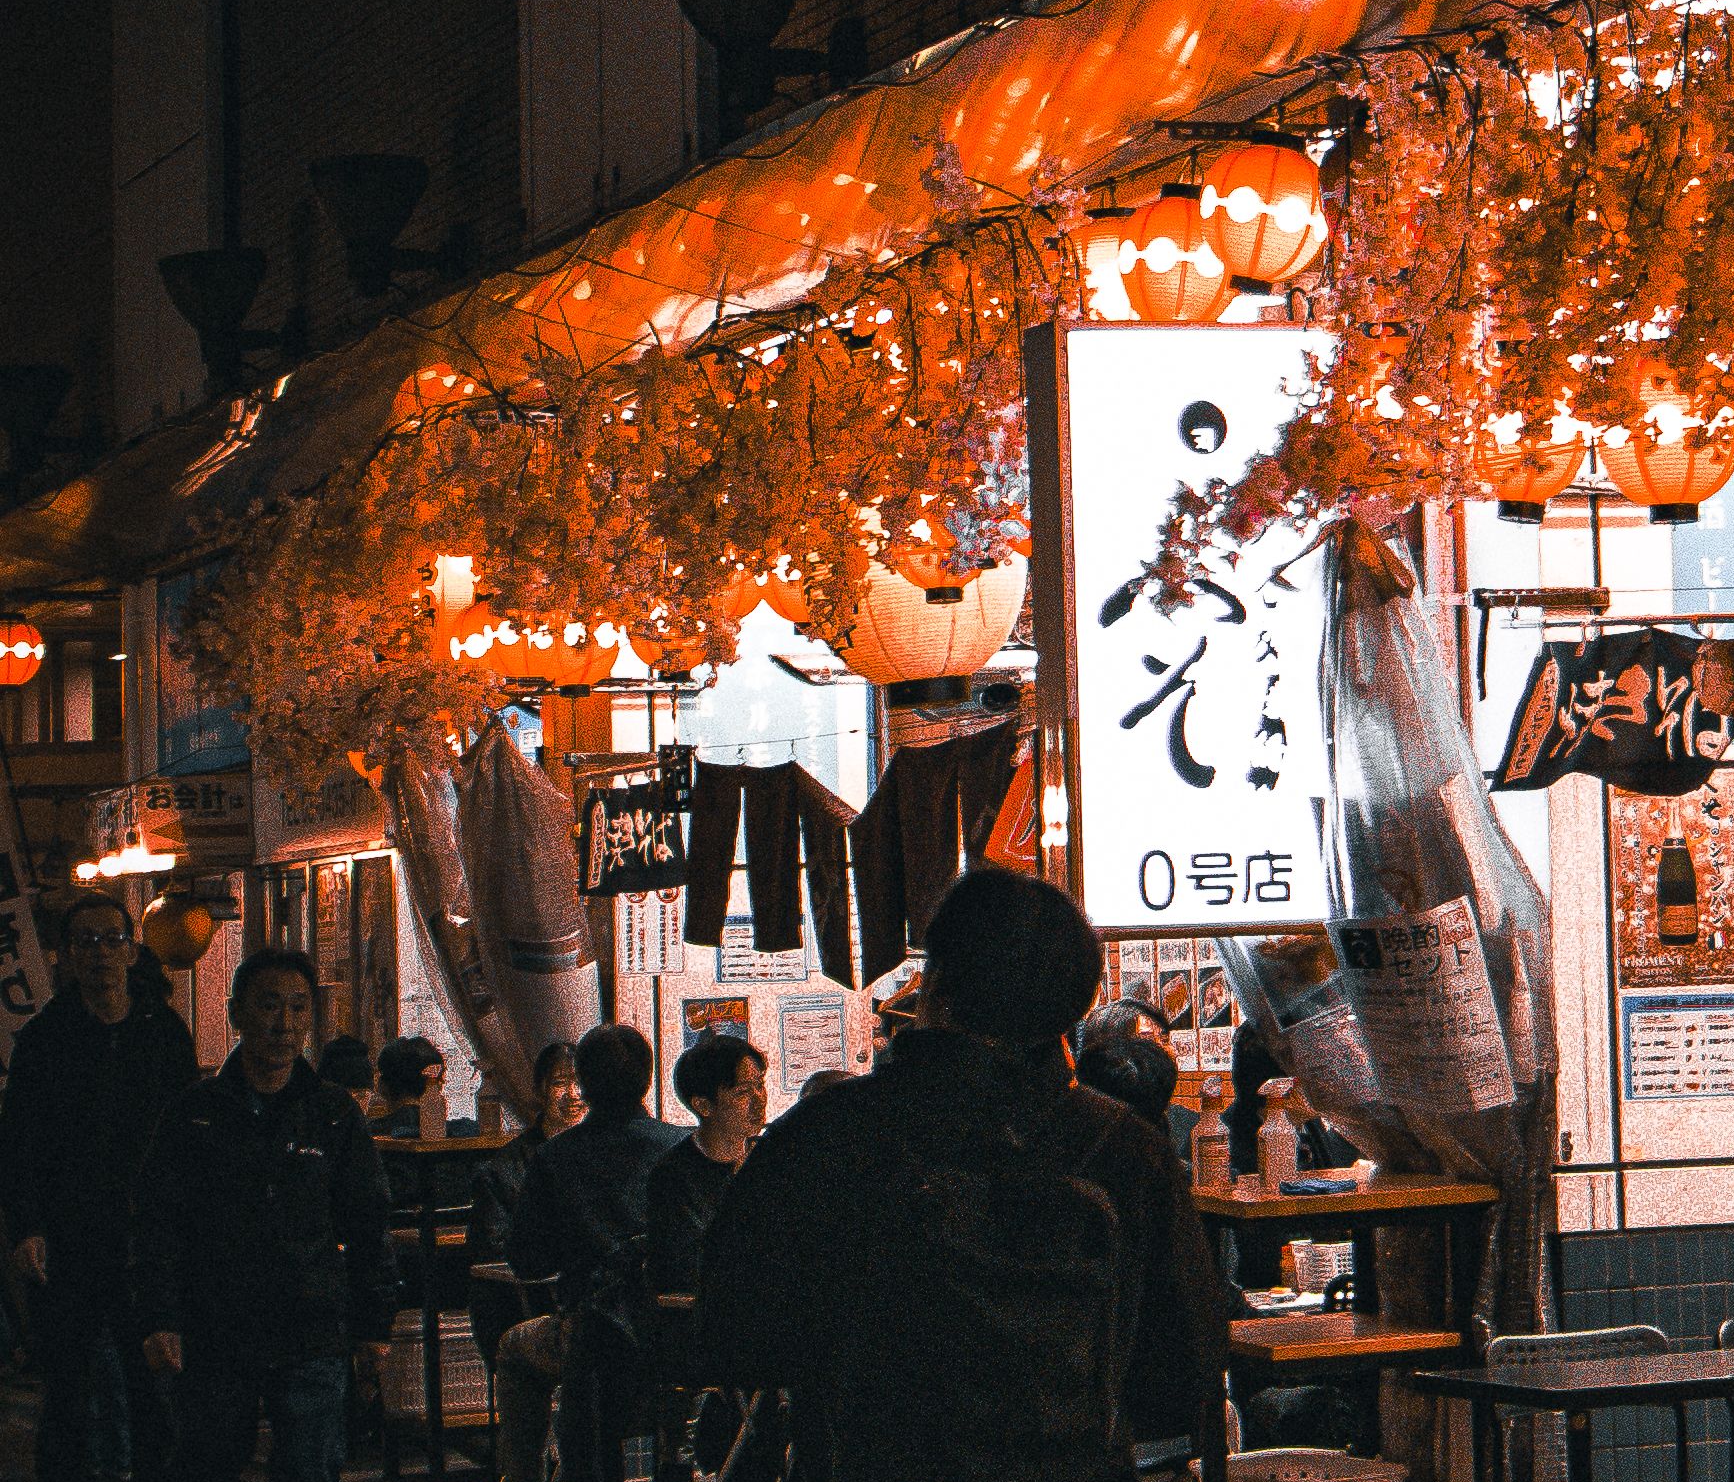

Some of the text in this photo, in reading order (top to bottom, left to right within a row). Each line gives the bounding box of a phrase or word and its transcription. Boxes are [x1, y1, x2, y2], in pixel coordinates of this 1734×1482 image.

[1137, 848, 1294, 912] 0号店
[1379, 923, 1440, 951] 晩酌
[1390, 944, 1471, 977] セット
